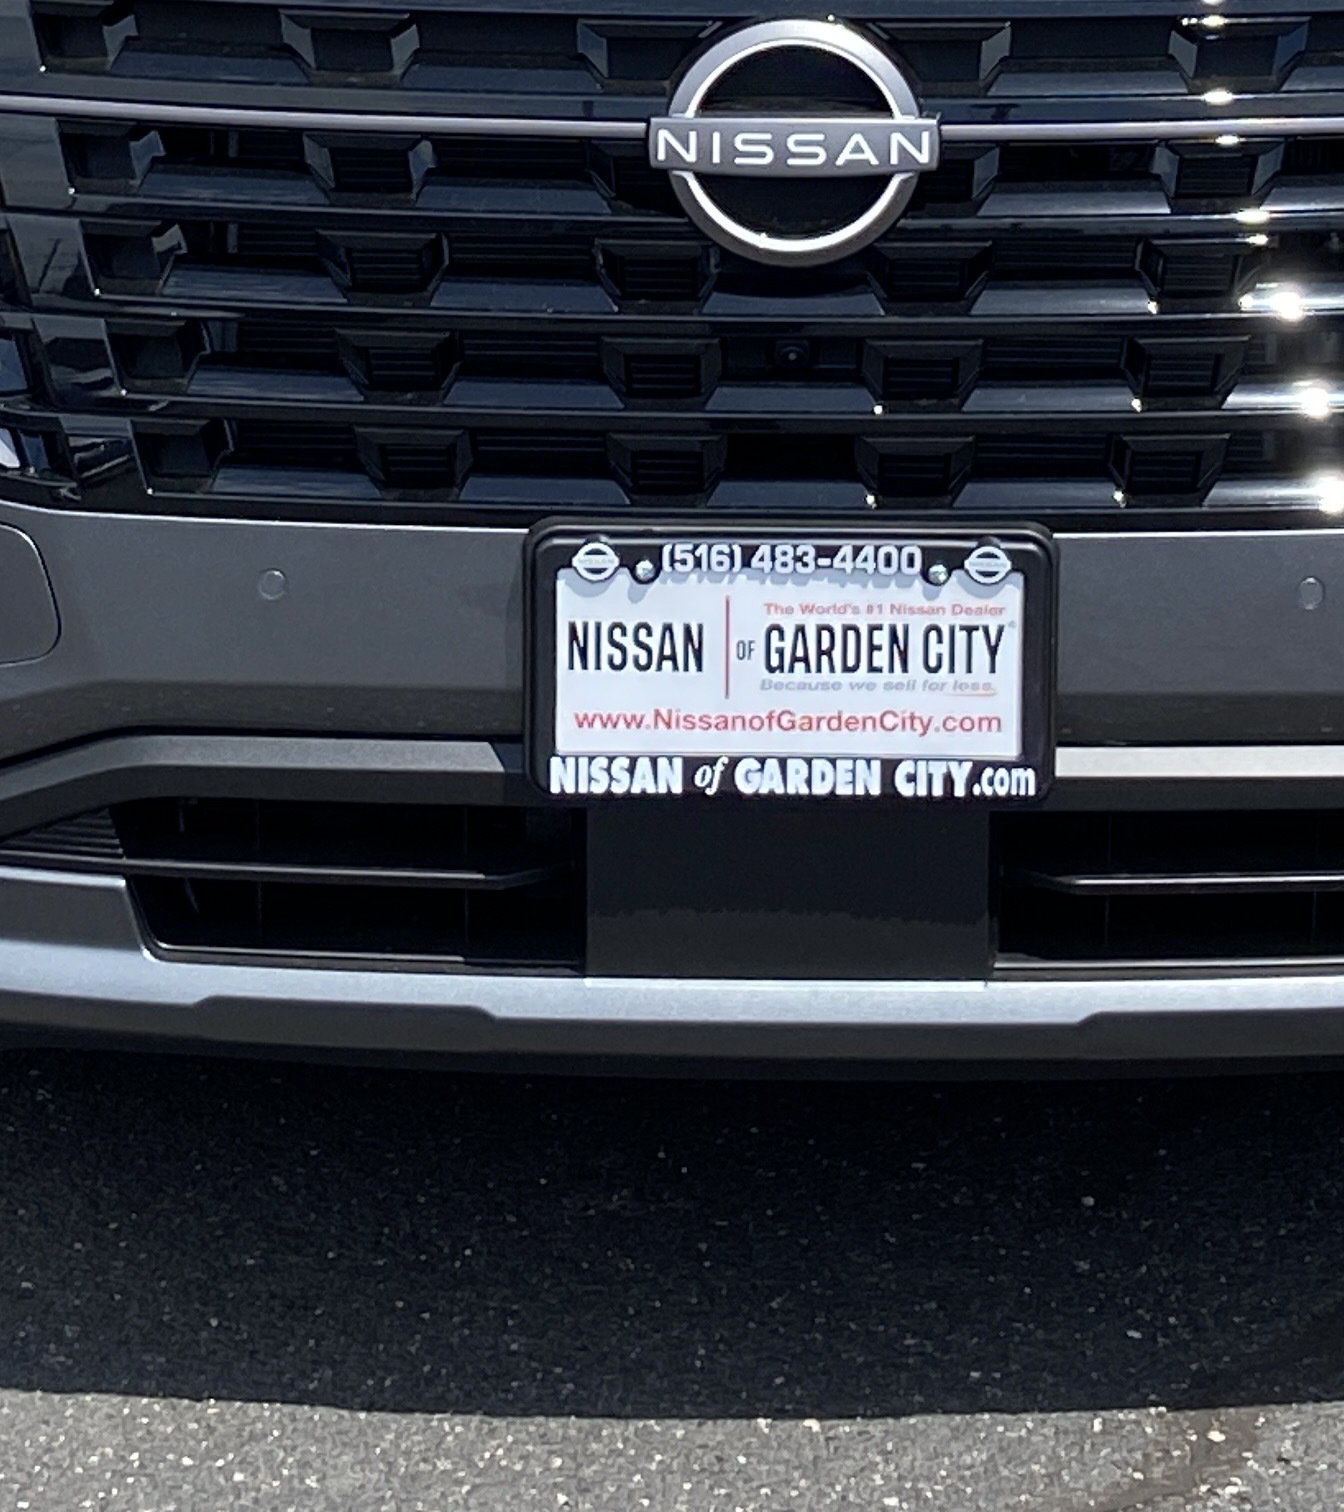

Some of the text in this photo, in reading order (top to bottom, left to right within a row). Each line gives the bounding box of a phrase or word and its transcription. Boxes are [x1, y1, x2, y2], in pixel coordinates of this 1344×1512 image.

[657, 129, 931, 166] NISSAN
[661, 543, 923, 576] (516) 483-4400
[763, 603, 795, 616] The
[799, 603, 861, 616] World's
[890, 603, 946, 617] Nissan
[951, 603, 1007, 617] Dealer
[567, 621, 1006, 675] NISSAN OF GARDEN CITY
[759, 679, 843, 692] Because
[848, 681, 871, 692] we
[883, 678, 918, 692] sell
[921, 679, 947, 692] for
[573, 708, 1002, 738] www.NissanofGardenCity.com
[549, 755, 684, 795] NISSAN
[694, 755, 729, 796] of
[734, 757, 882, 796] GARDEN
